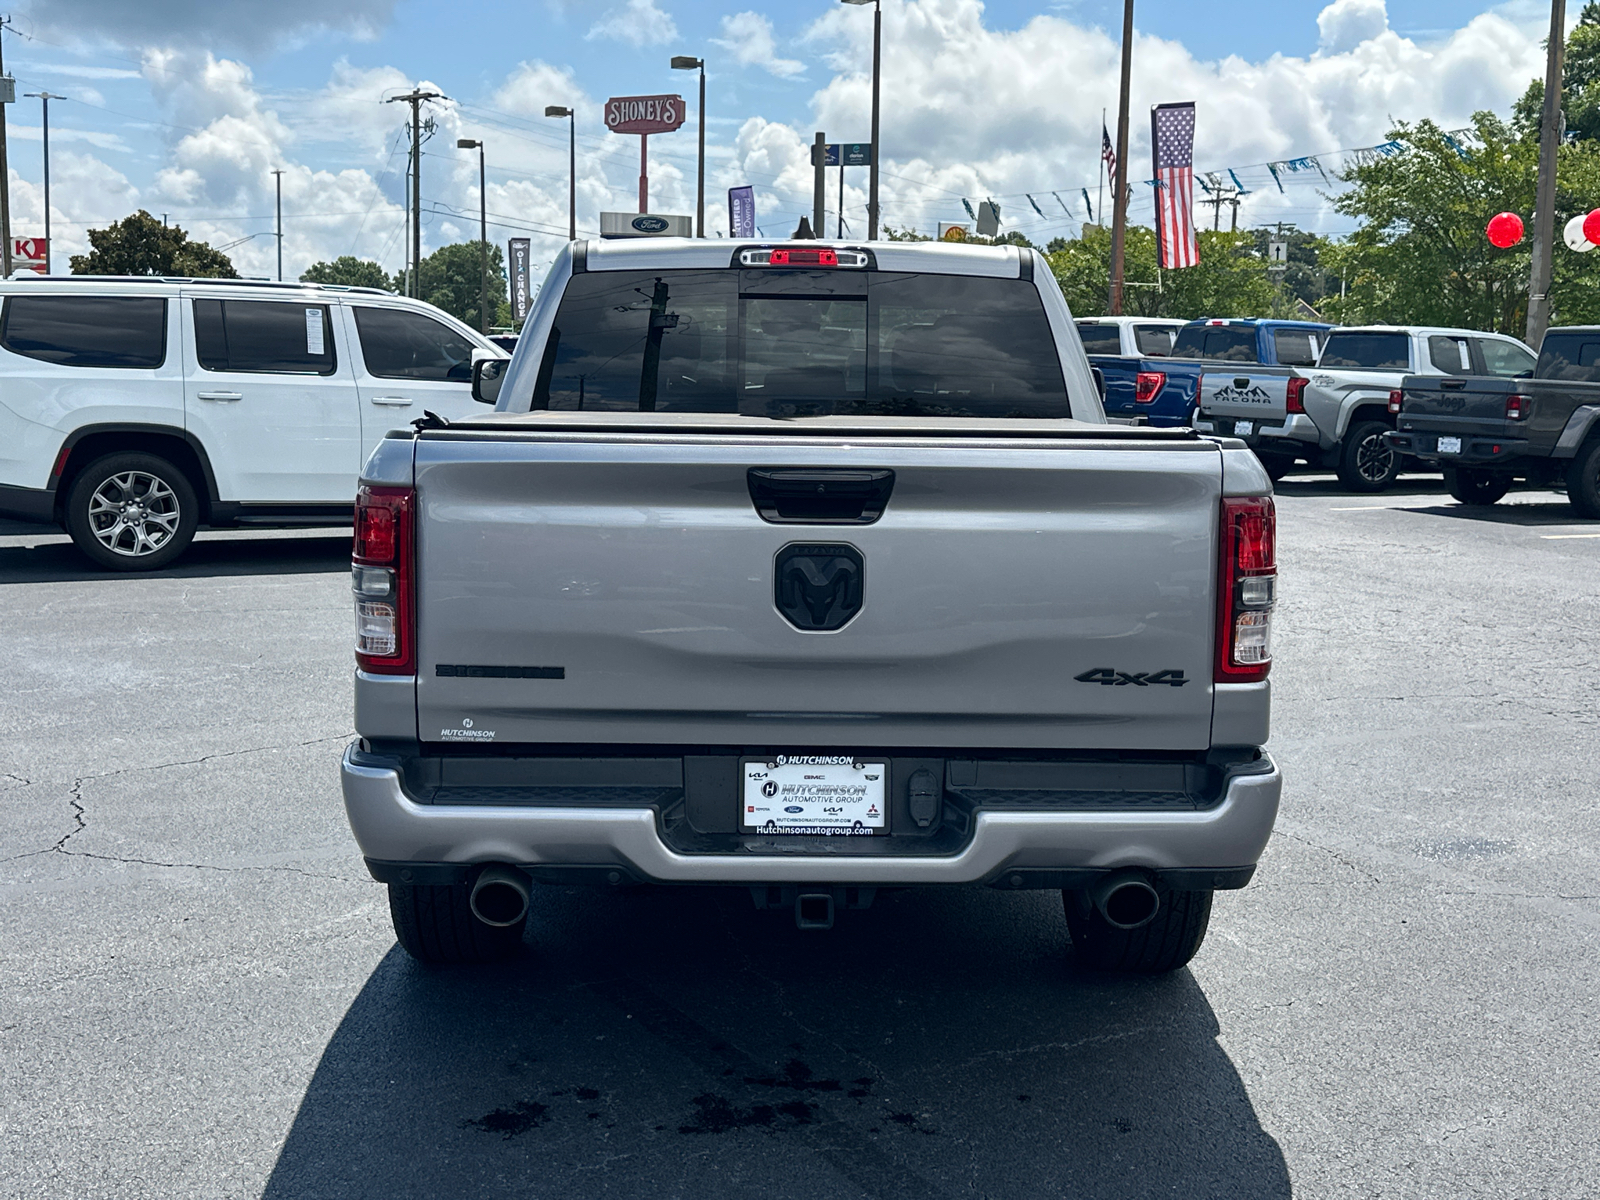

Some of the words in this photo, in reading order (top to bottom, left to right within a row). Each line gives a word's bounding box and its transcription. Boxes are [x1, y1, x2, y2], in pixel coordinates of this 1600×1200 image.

[608, 97, 676, 126] SHONEY'S
[743, 197, 752, 237] e-Owned
[641, 220, 661, 229] Ford
[15, 240, 33, 259] K
[517, 274, 526, 317] CHANGE
[1214, 396, 1271, 405] TACOMA
[1437, 394, 1466, 410] Jeep
[793, 546, 846, 554] RAM
[1073, 668, 1190, 686] 4x4
[441, 729, 496, 738] HUTCHINSON
[788, 756, 854, 765] HUTCHINSON
[781, 784, 867, 796] HUTCHINSON
[756, 826, 874, 836] Hutchinsonautogroup.com
